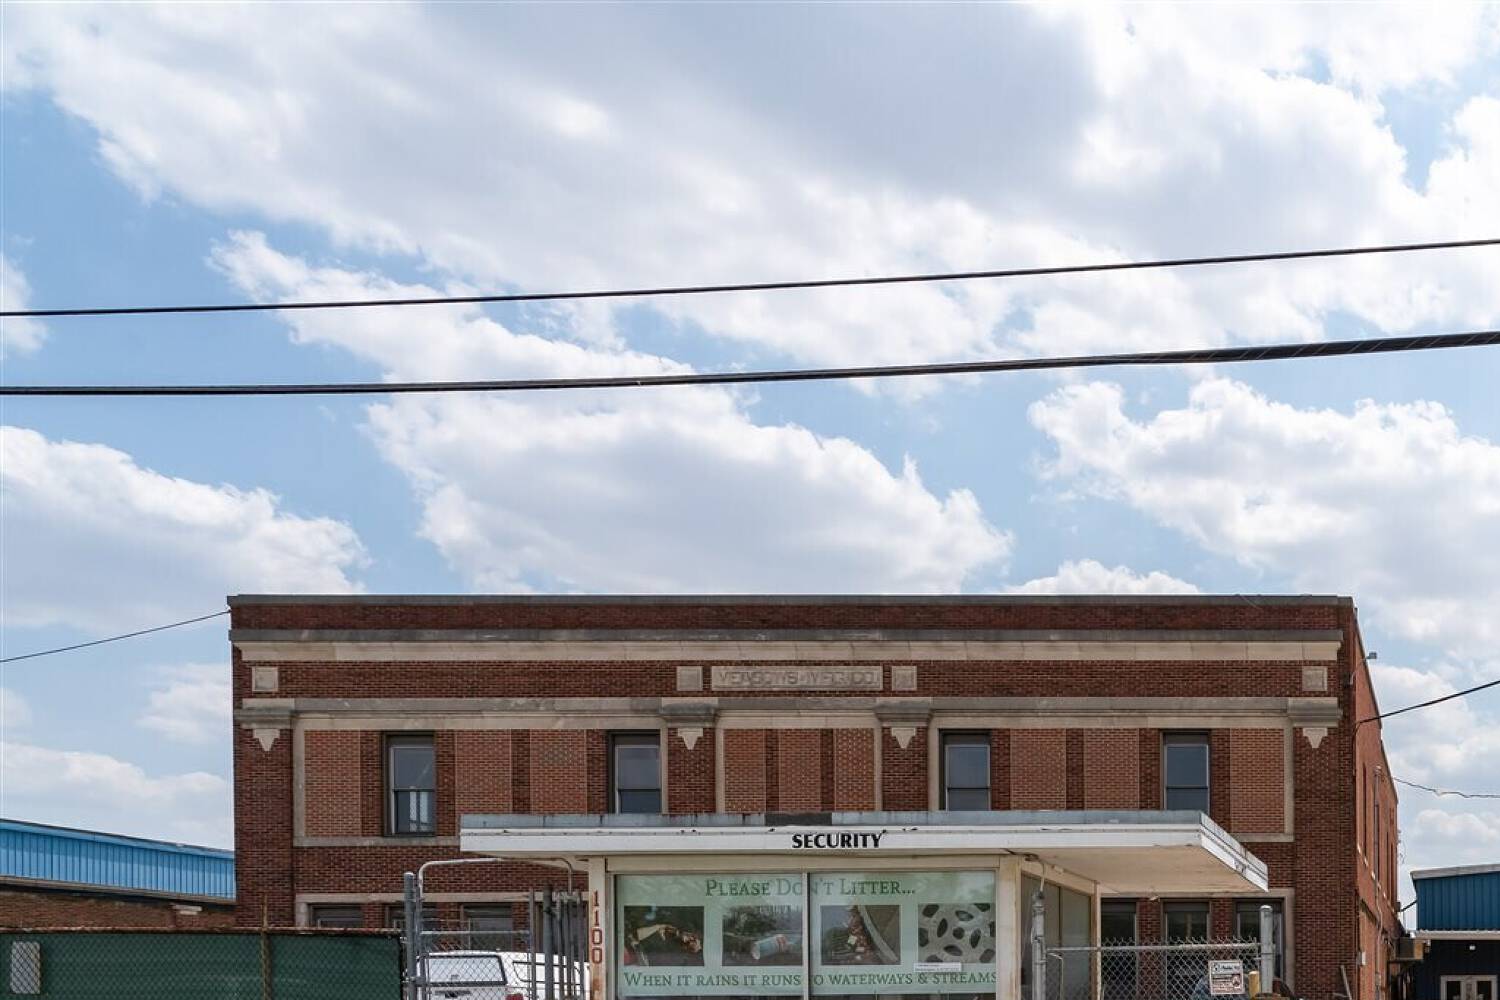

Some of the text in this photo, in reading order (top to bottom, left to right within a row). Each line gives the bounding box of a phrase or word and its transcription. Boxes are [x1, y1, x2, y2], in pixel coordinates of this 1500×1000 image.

[791, 832, 881, 849] SECURITY
[705, 878, 770, 897] PLEASE
[776, 877, 833, 896] DON'T
[592, 890, 602, 964] 1100
[623, 971, 672, 986] WHEN
[676, 974, 694, 986] IT
[695, 974, 739, 986] RAINS
[743, 974, 758, 986] IT
[762, 974, 801, 986] RUNS
[828, 973, 913, 986] WATERWAYS
[917, 971, 929, 985] &
[932, 971, 996, 985] STREAMS
